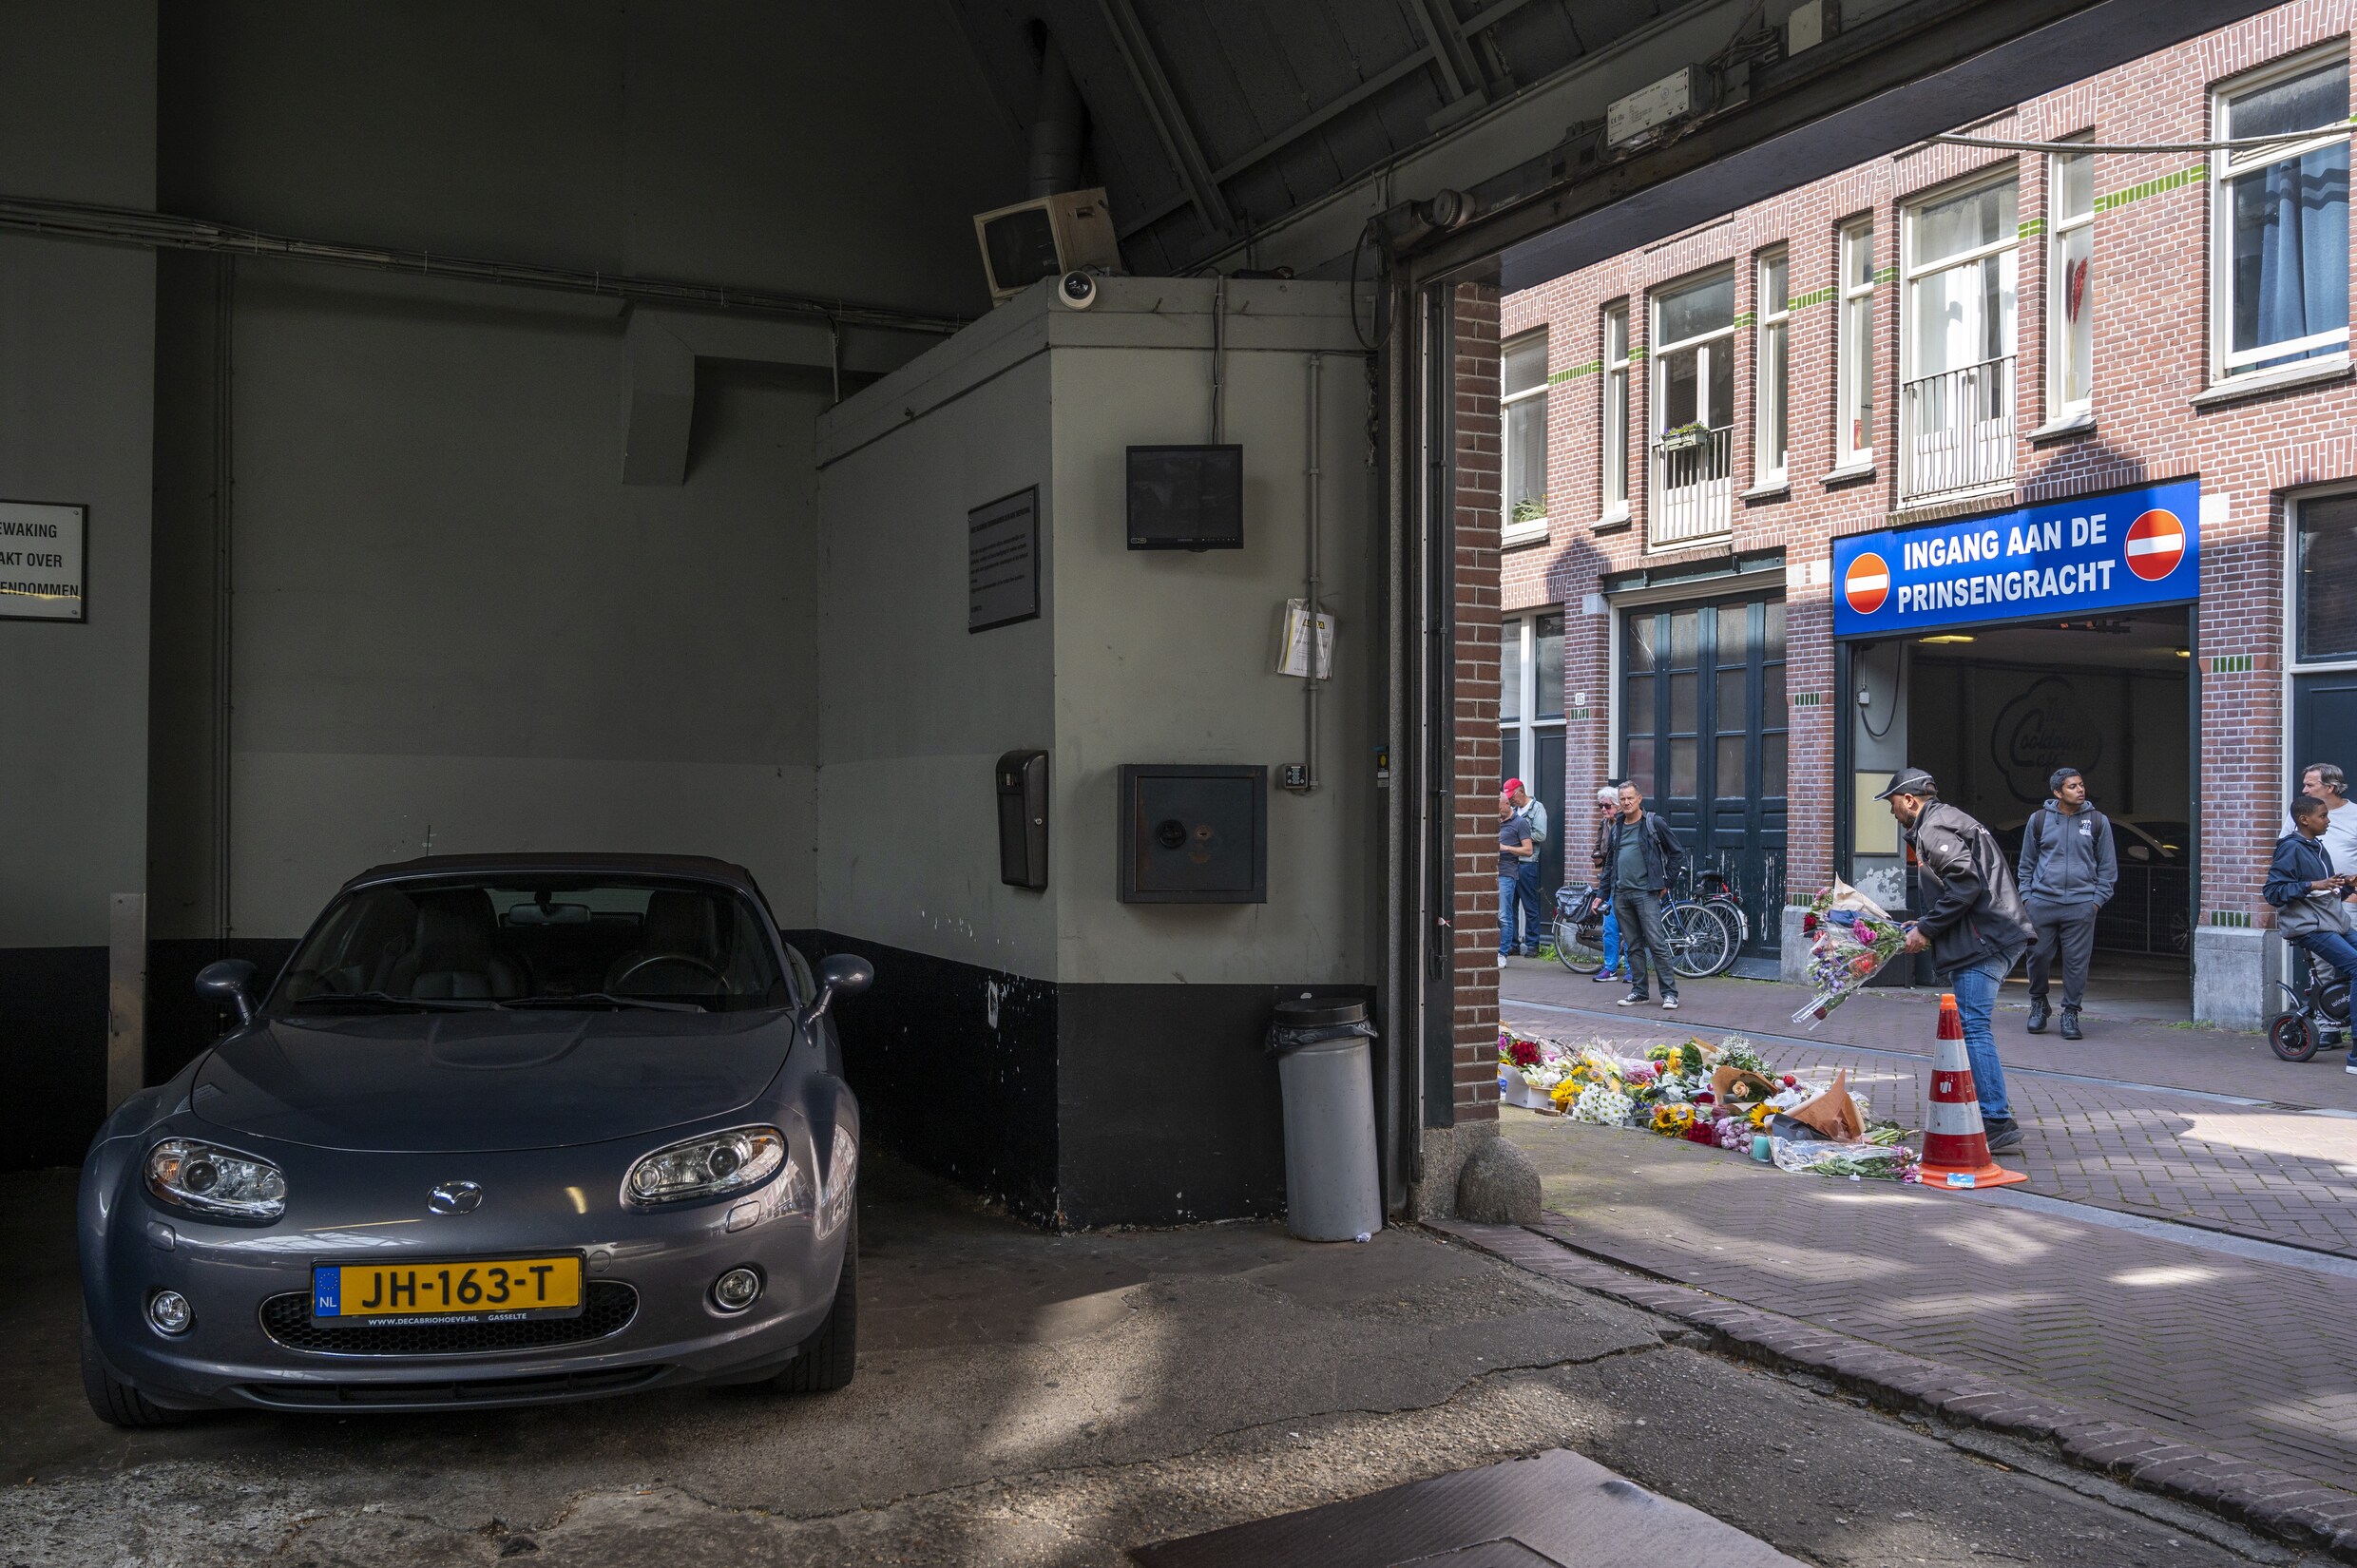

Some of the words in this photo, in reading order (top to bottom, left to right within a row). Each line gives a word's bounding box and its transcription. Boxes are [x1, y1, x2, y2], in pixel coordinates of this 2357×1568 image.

[0, 522, 57, 538] WAKING
[1904, 530, 2000, 570] INGANG
[2006, 520, 2061, 557] AAN
[2071, 513, 2107, 547] DE
[27, 552, 62, 568] OVER
[0, 582, 79, 598] ENDOMMEN
[1898, 559, 2117, 614] PRINSENGRACHT
[361, 1266, 553, 1309] JH-163-T
[319, 1296, 337, 1309] NL
[368, 1315, 479, 1326] WWW.DECABRIOHOEVE.NL
[488, 1312, 527, 1322] GASSELTE
